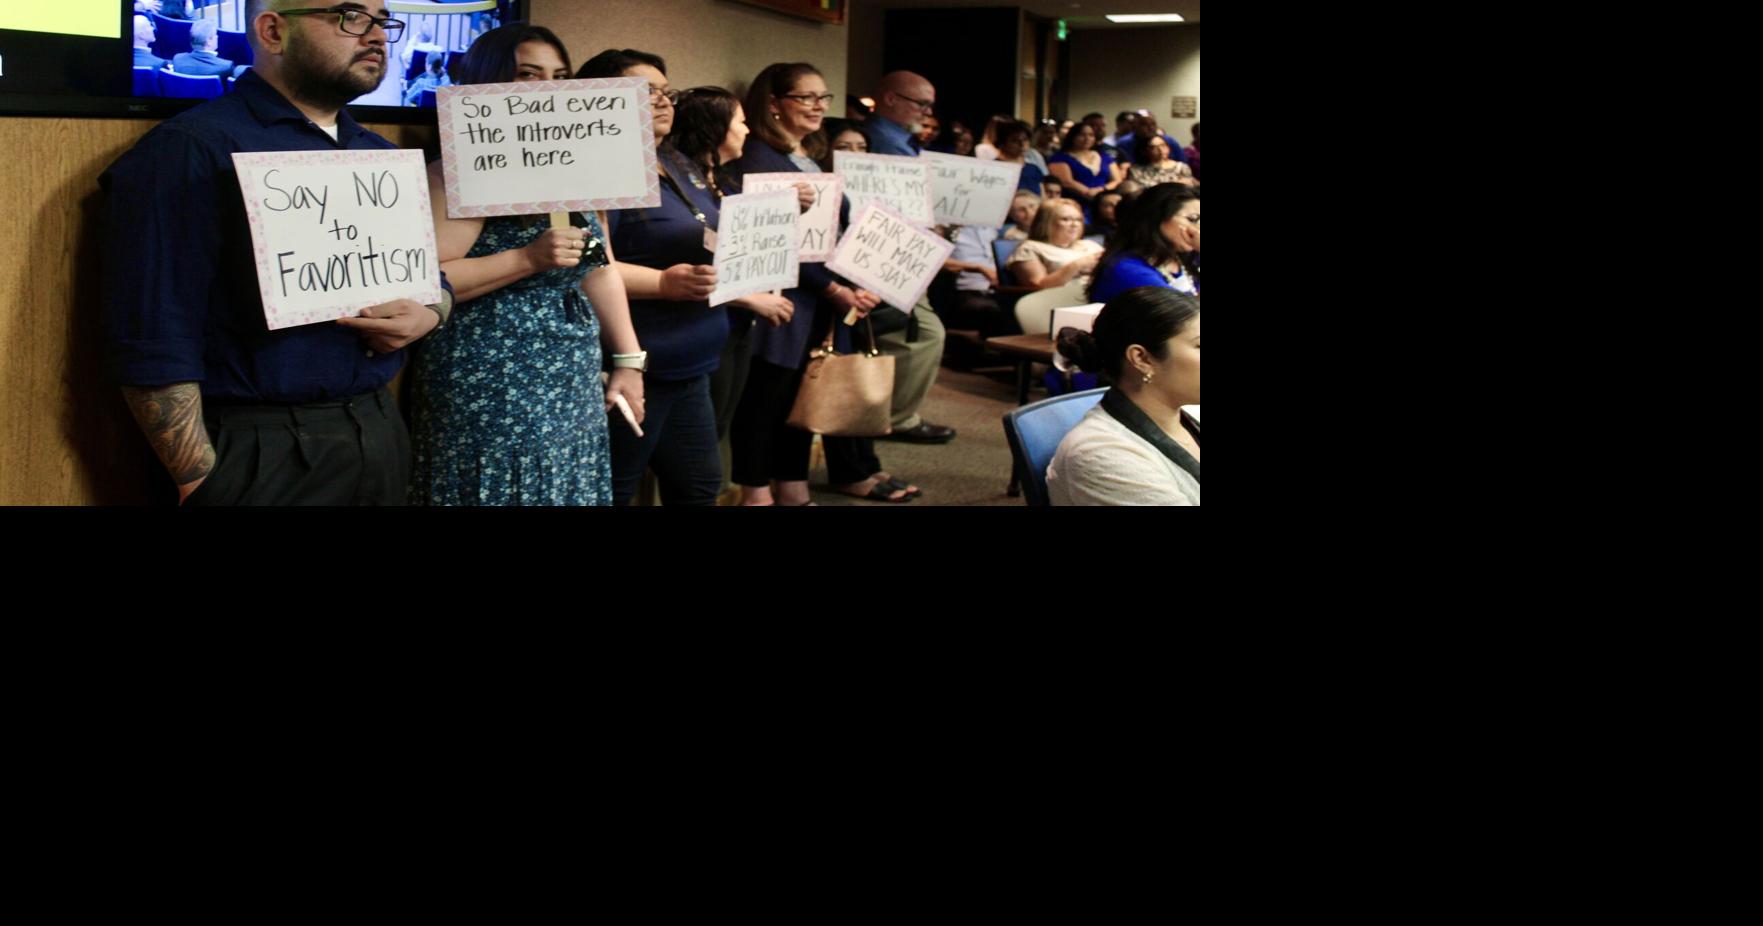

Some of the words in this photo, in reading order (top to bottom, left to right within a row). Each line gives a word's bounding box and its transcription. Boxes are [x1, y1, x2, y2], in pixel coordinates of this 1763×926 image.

[461, 96, 492, 118] So
[503, 95, 555, 116] Bad
[567, 95, 626, 113] even
[459, 122, 506, 144] the
[474, 153, 507, 171] are
[522, 147, 575, 167] here
[263, 169, 328, 224] Say
[352, 170, 399, 208] NO
[328, 219, 358, 241] to
[868, 210, 905, 244] FAIR
[906, 233, 937, 259] PAY
[277, 236, 426, 297] Favoritism
[853, 248, 871, 270] US
[878, 261, 912, 290] STAY
[856, 225, 887, 252] WILL
[890, 246, 929, 278] MAKE
